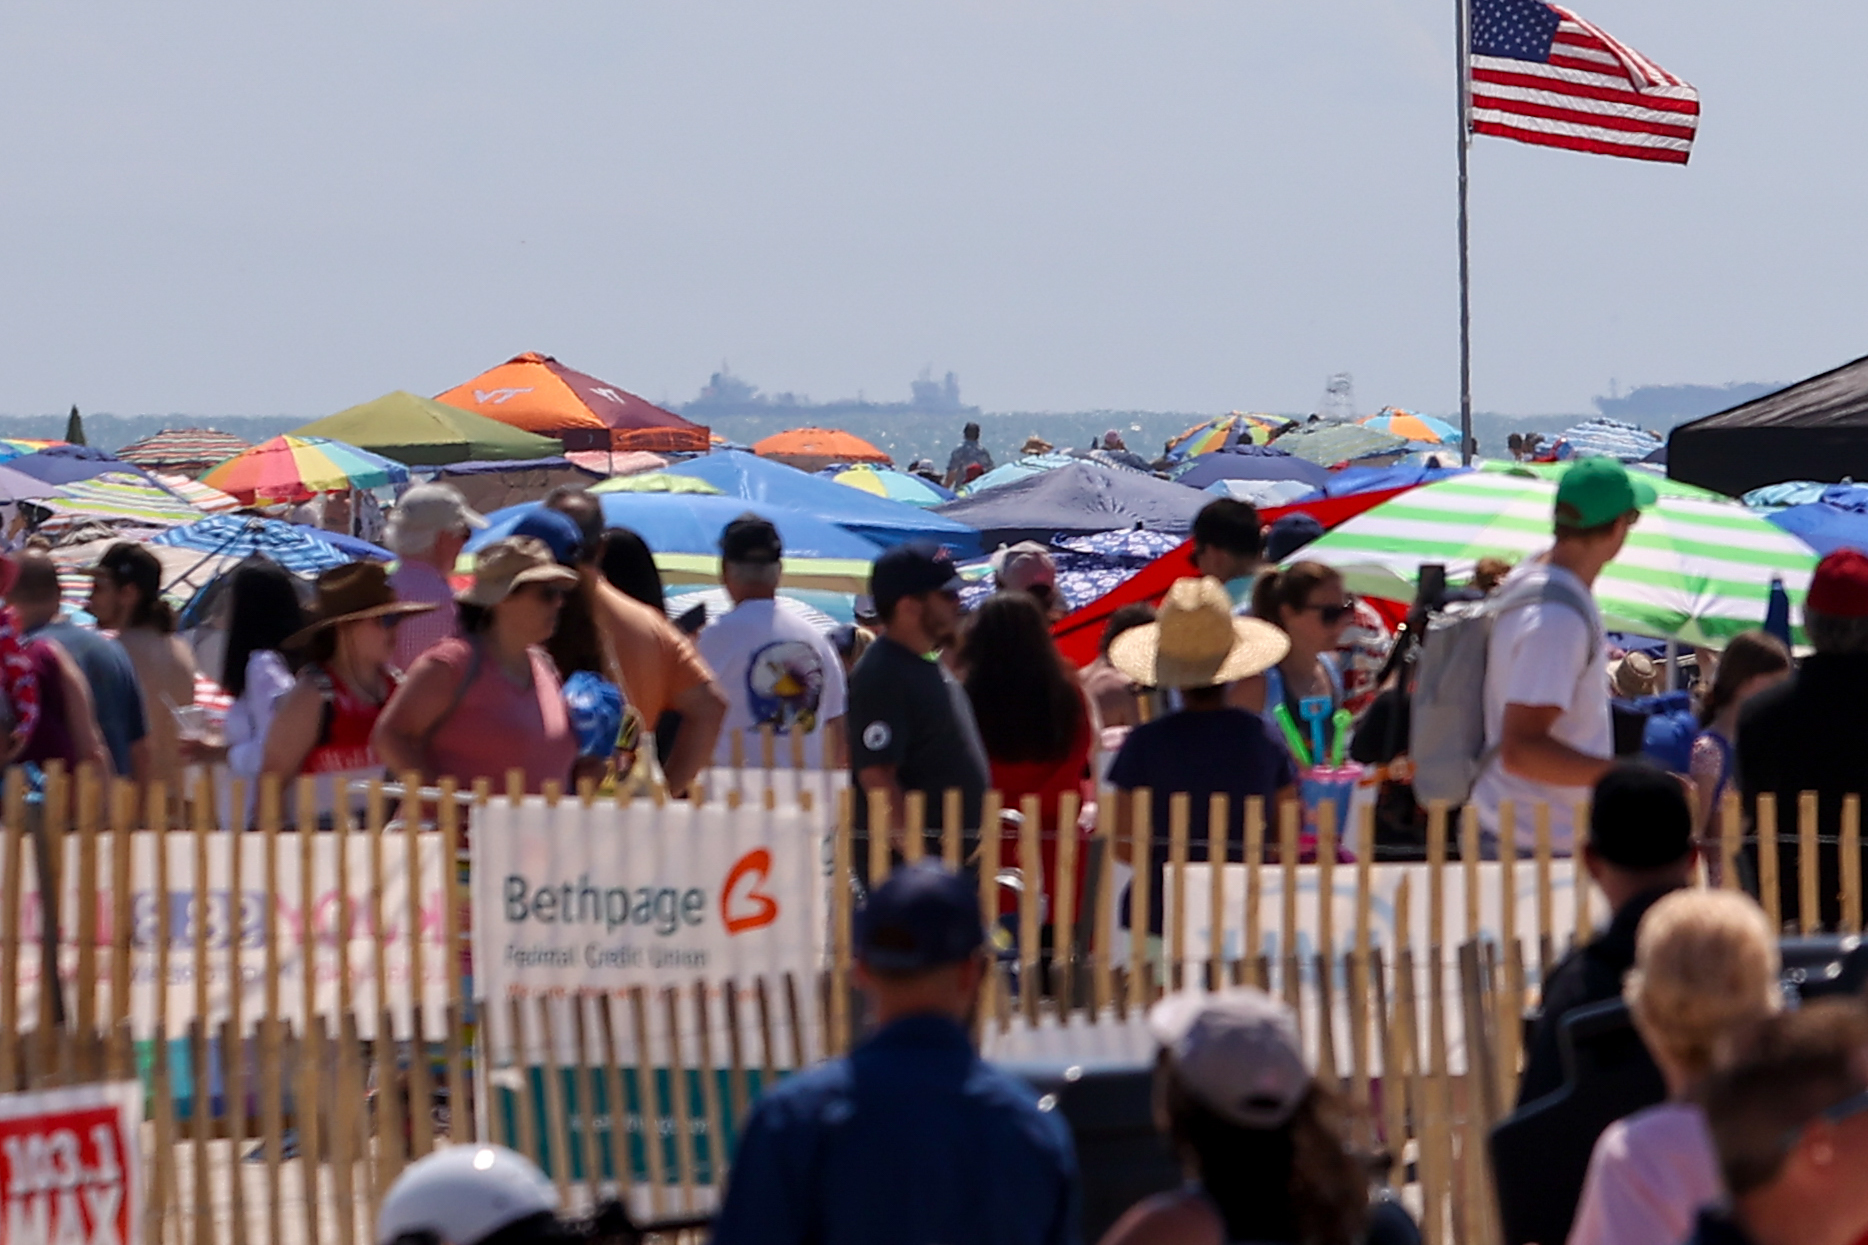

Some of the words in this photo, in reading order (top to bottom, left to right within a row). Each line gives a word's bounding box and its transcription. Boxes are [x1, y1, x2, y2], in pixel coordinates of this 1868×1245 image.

[474, 387, 535, 404] VT
[504, 874, 707, 935] Bethpage
[3, 1122, 121, 1195] 103.1
[7, 1184, 122, 1245] MAX
